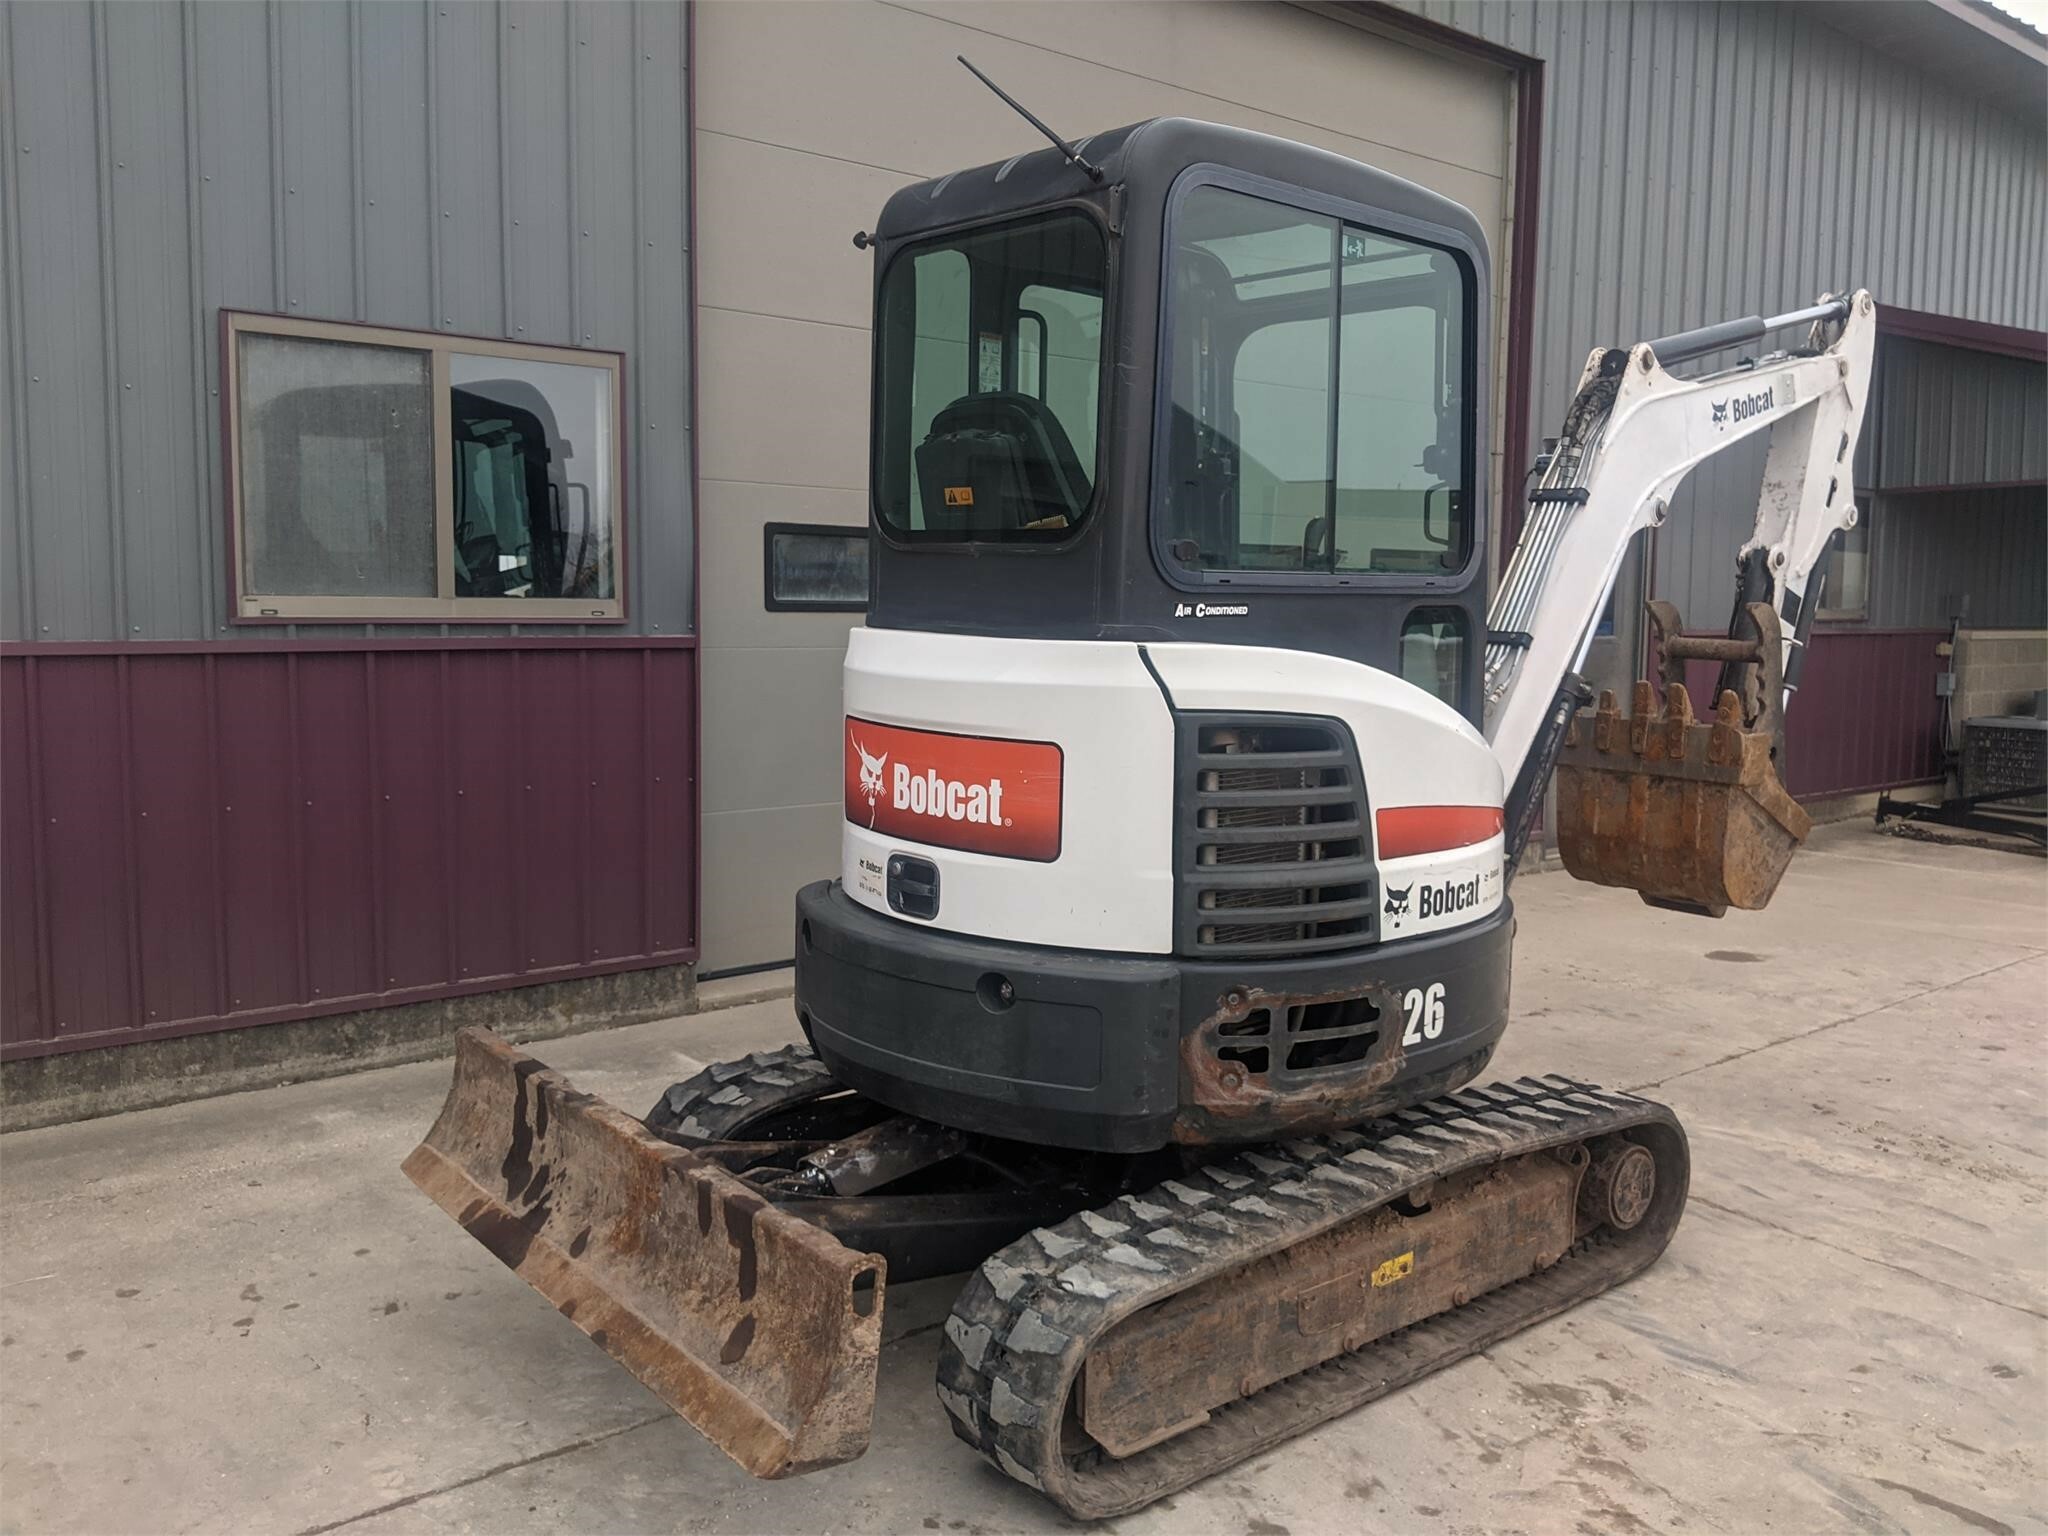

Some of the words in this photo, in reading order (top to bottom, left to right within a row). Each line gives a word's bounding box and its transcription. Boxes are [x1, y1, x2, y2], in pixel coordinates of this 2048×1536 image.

[1732, 385, 1774, 423] Bobcat
[893, 762, 1003, 826] Bobcat
[1419, 873, 1480, 919] Bobcat
